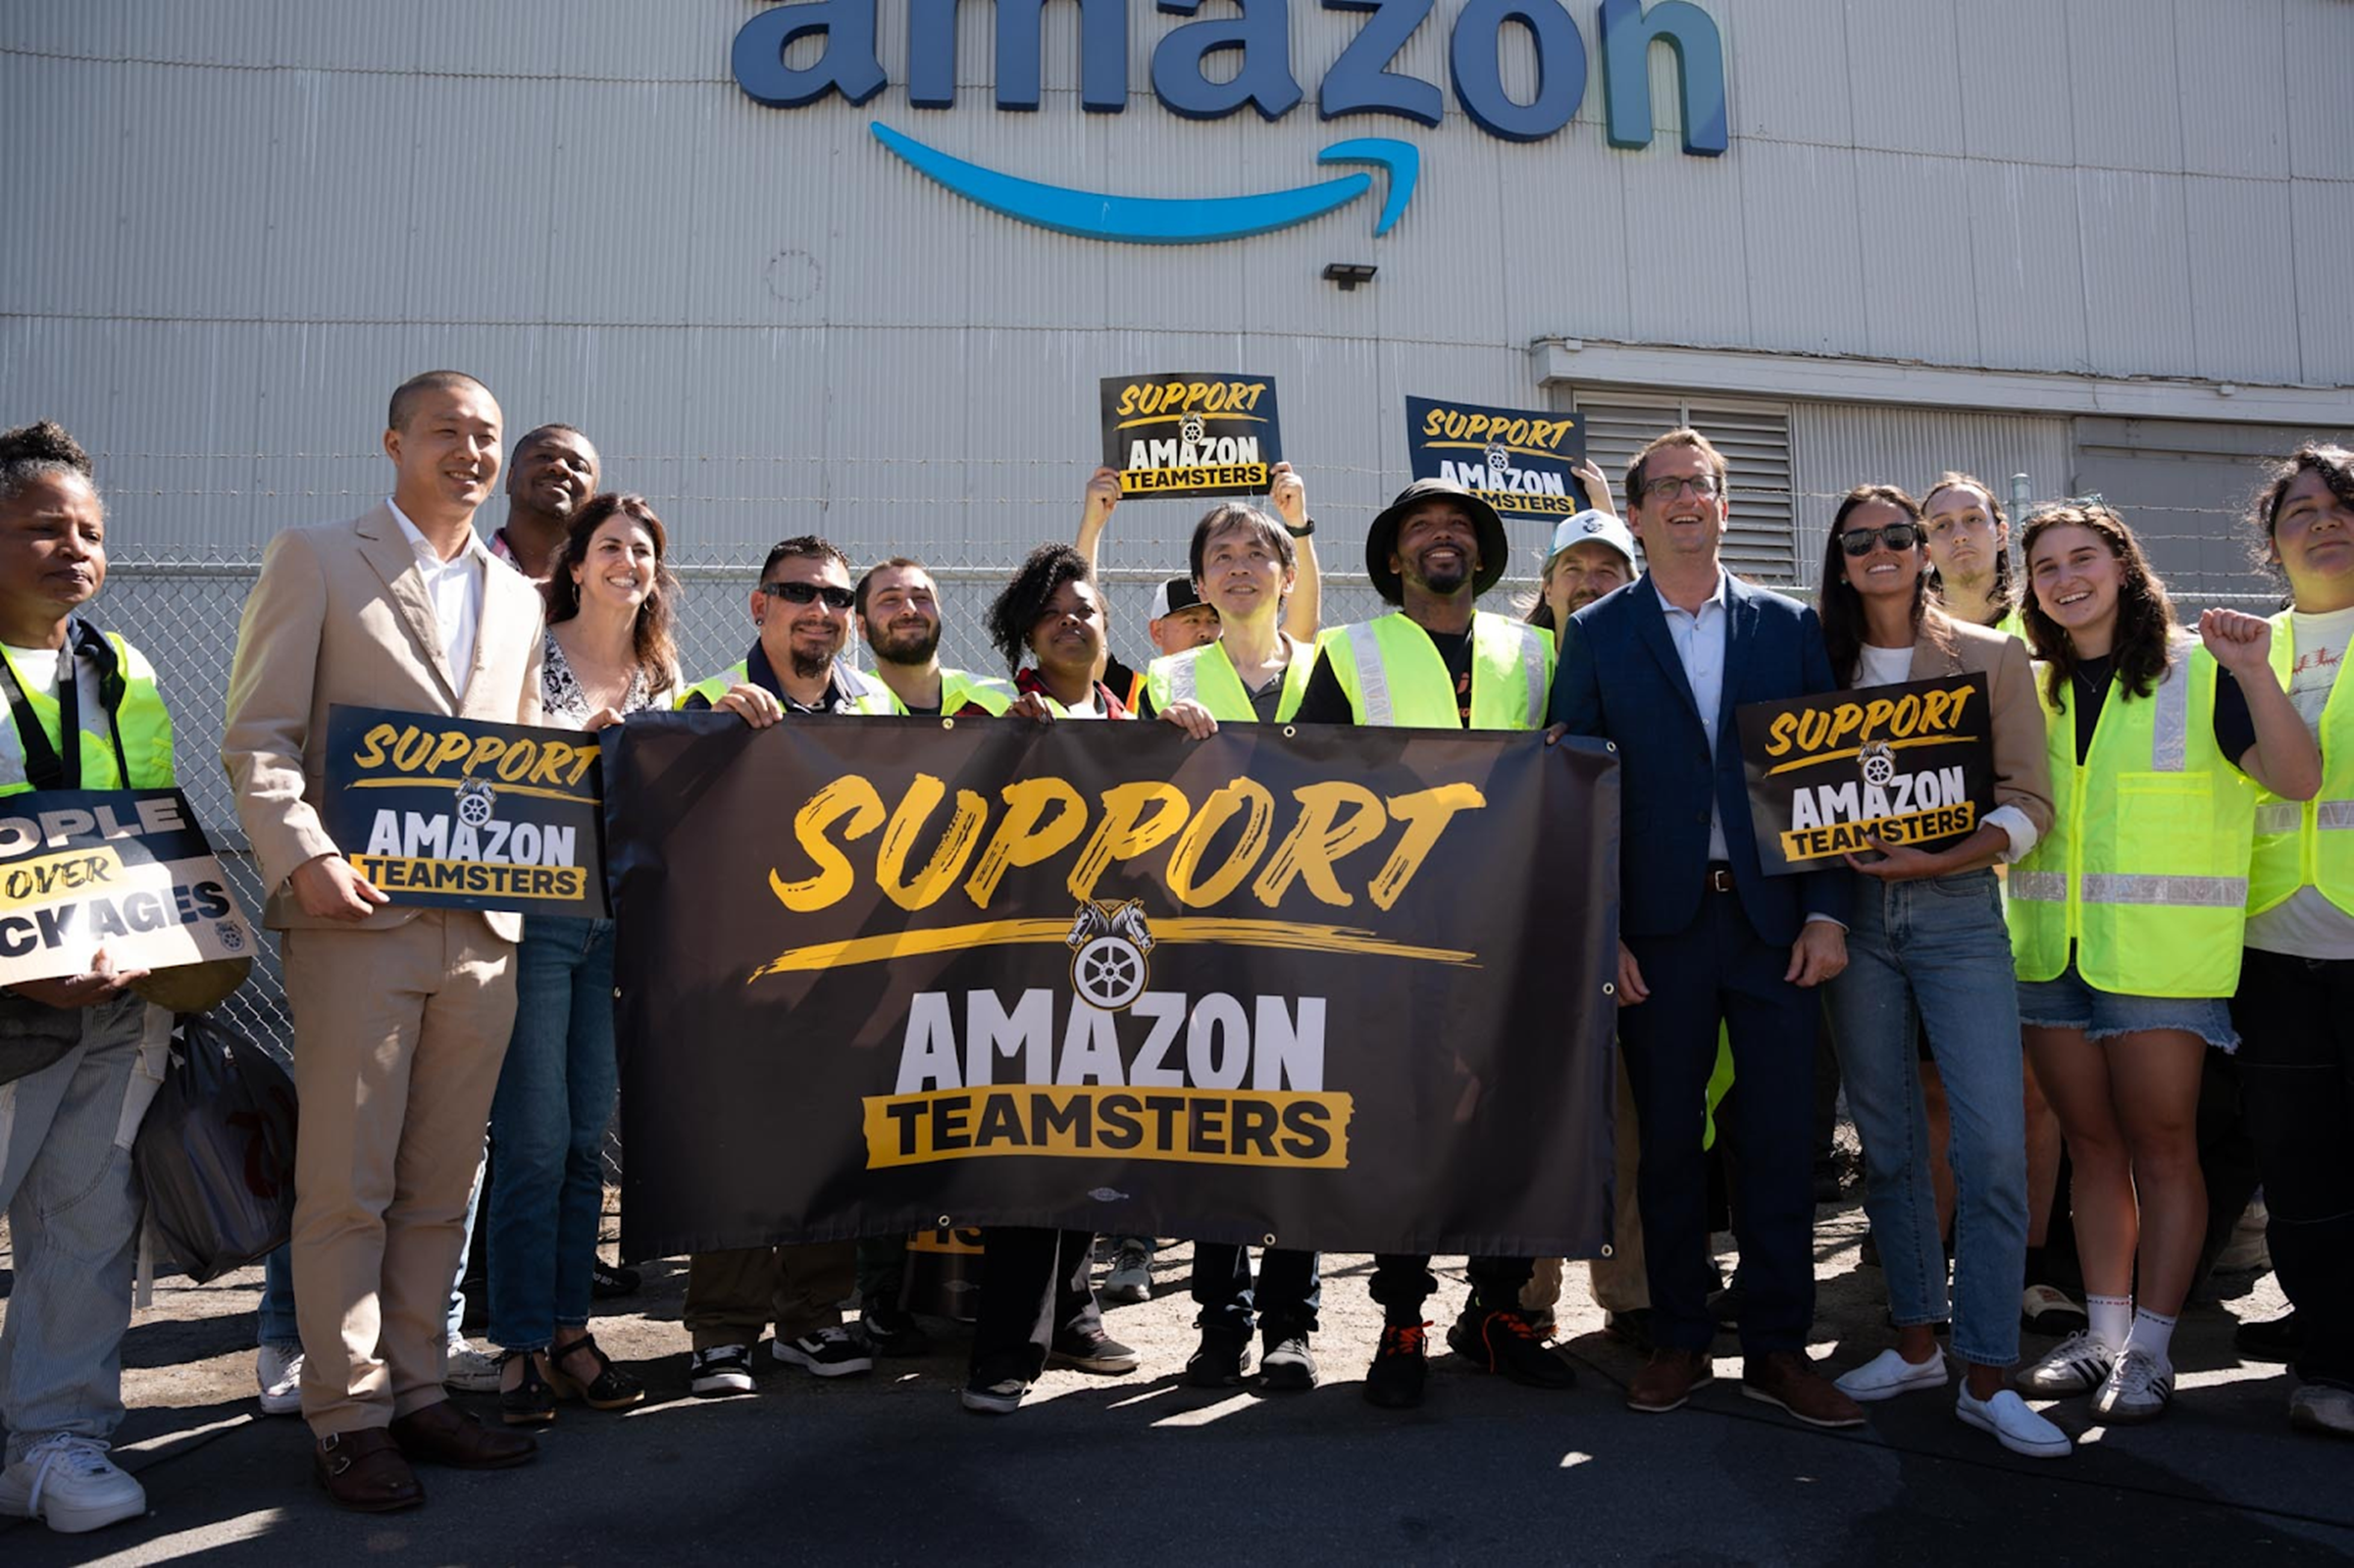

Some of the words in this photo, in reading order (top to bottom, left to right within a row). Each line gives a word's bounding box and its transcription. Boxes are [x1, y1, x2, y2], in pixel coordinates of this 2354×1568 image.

[732, 0, 1730, 157] amazon
[1116, 381, 1266, 417] SUPPORT
[1129, 436, 1259, 471] AMAZON
[1423, 408, 1574, 449] SUPPORT
[1127, 466, 1262, 489] TEAMSTERS
[1441, 460, 1565, 497] AMAZON
[1766, 684, 1975, 756] SUPPORT
[353, 724, 601, 786] SUPPORT
[1792, 766, 1967, 831] AMAZON
[366, 809, 576, 867] AMAZON
[769, 774, 1486, 912] SUPPORT
[1790, 807, 1970, 856] TEAMSTERS
[5, 855, 112, 899] OVER
[362, 859, 577, 895] TEAMSTERS
[894, 988, 1326, 1092] AMAZON
[886, 1093, 1332, 1158] TEAMSTERS
